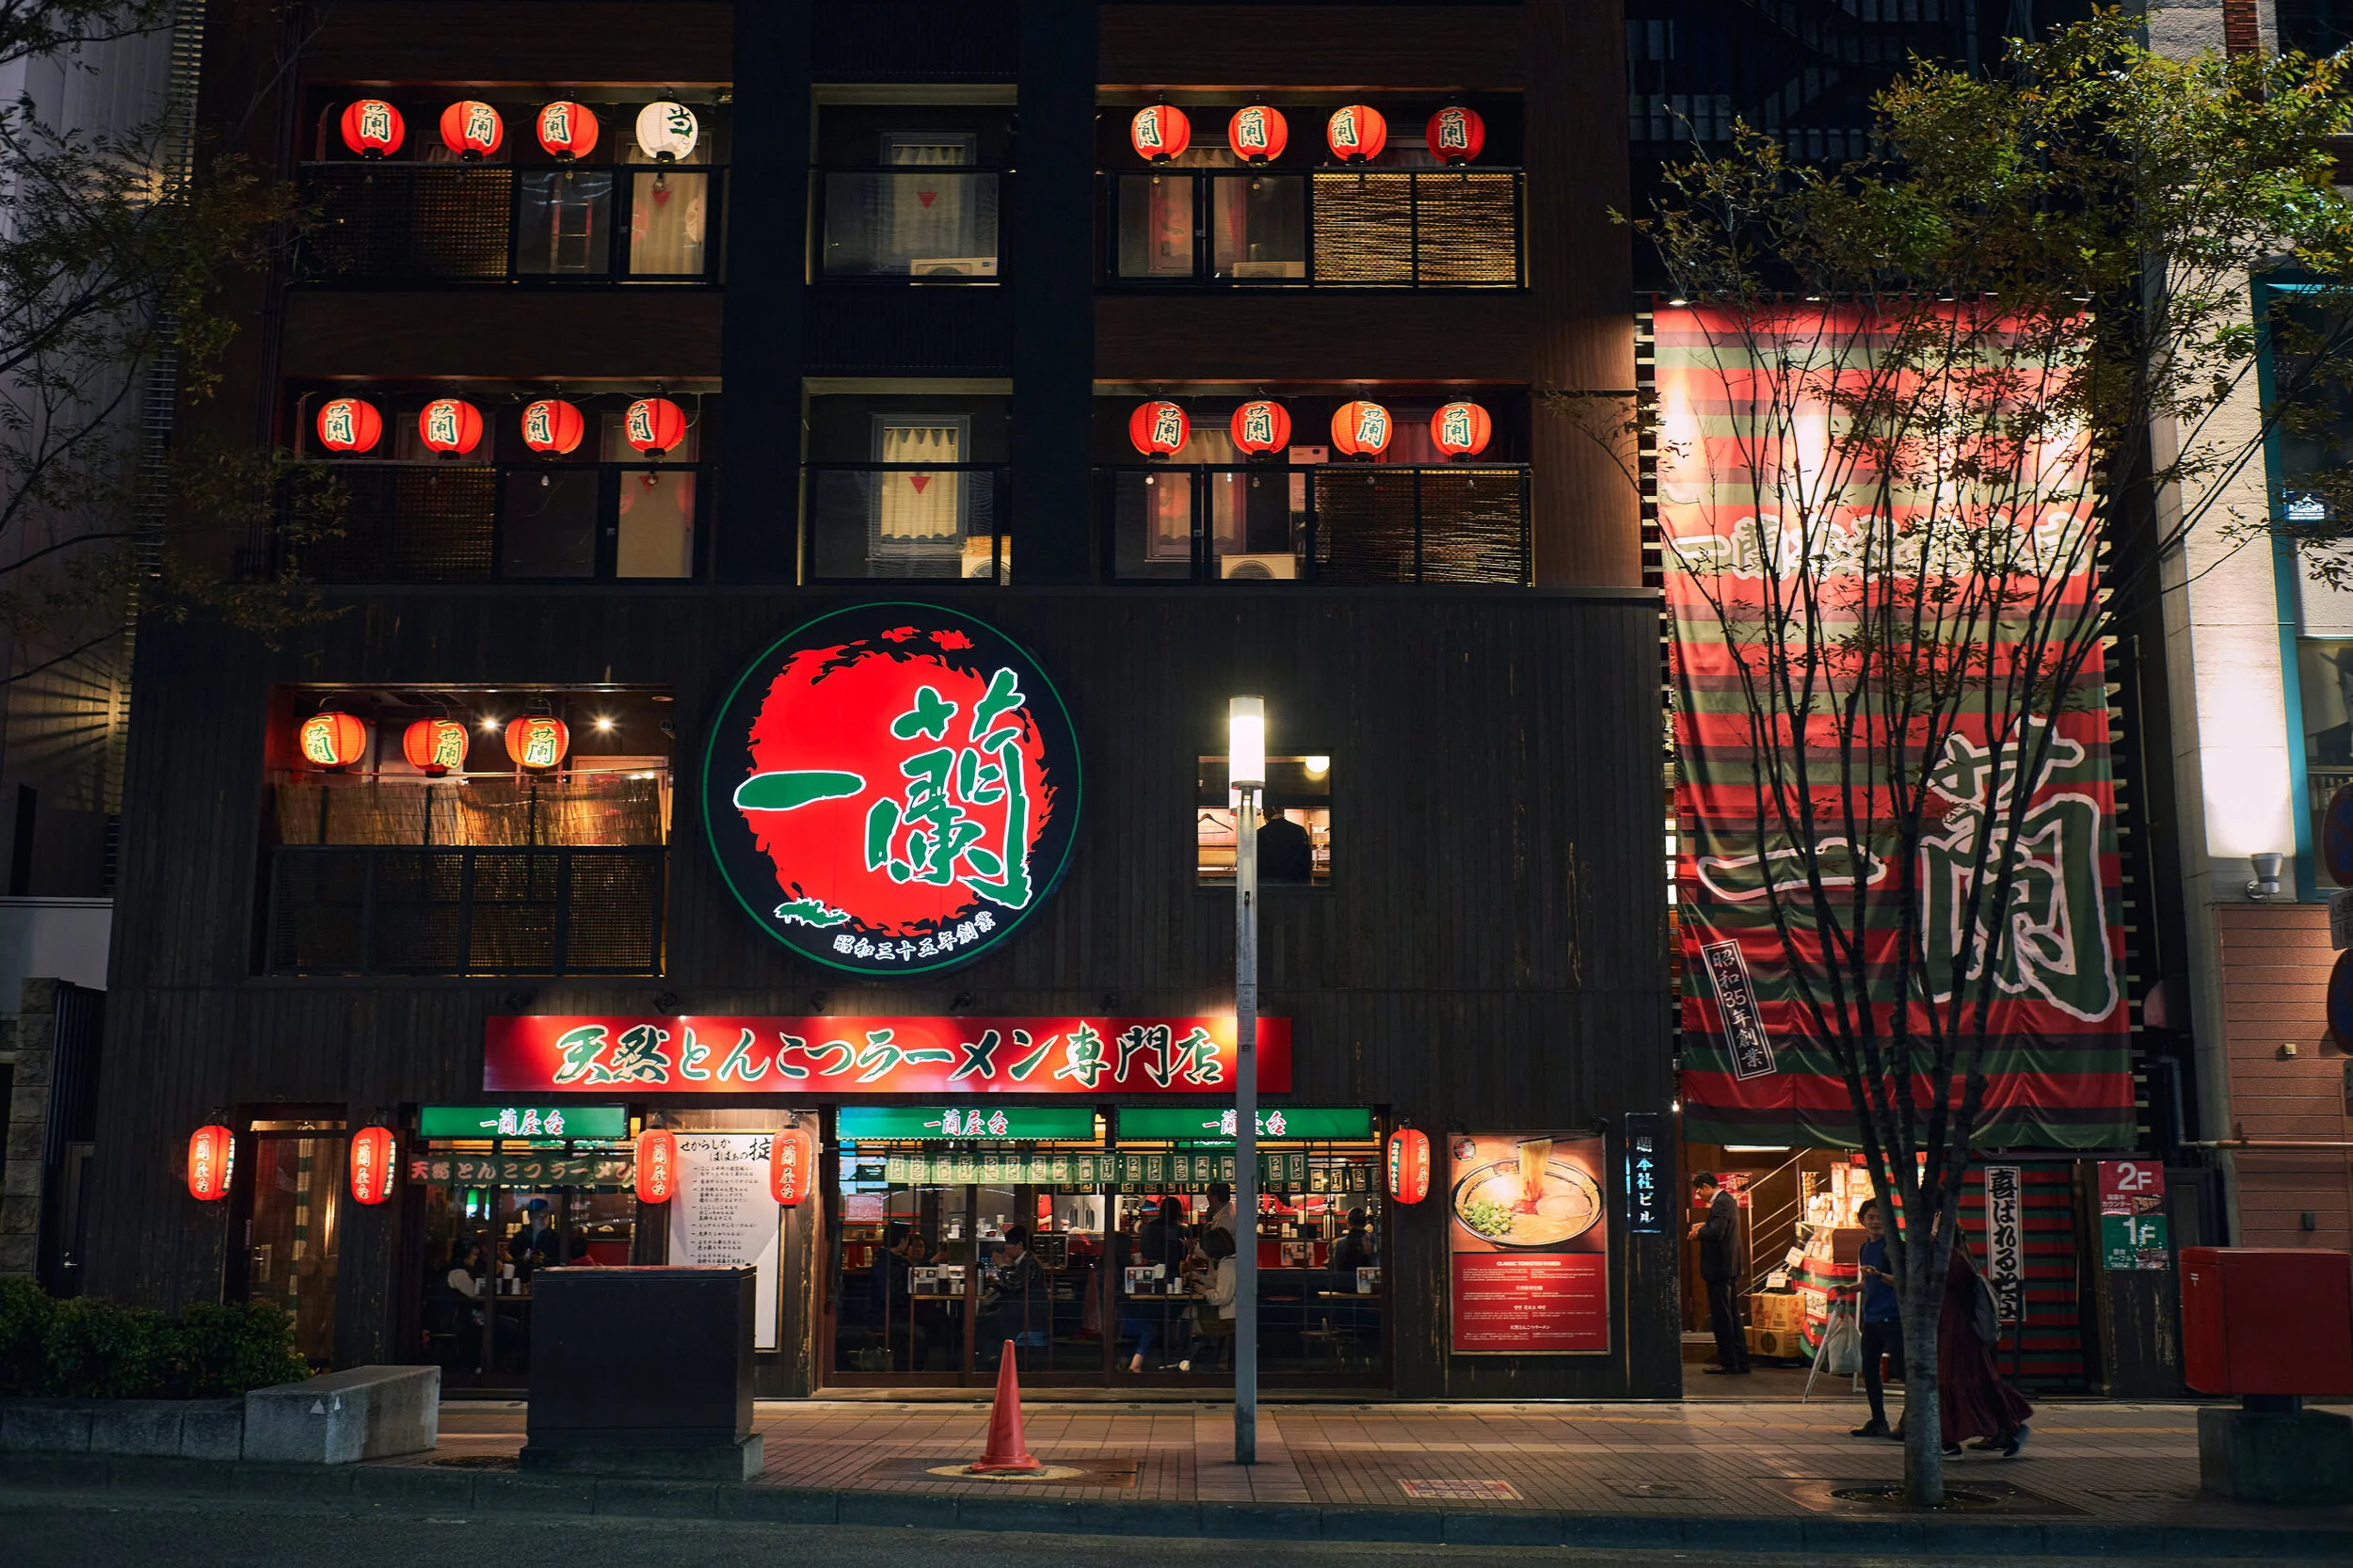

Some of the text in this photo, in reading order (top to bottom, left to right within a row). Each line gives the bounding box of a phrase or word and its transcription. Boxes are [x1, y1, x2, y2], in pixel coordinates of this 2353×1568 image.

[307, 715, 339, 764] 一蘭
[434, 719, 462, 768] 一蘭
[526, 718, 557, 766] 一蘭
[733, 667, 1033, 909] 一蘭
[1697, 717, 2118, 1022] 一蘭
[833, 911, 997, 961] 昭和三十五年創業
[1713, 949, 1764, 1067] 昭和35年創業
[552, 1021, 1225, 1088] 天然とんこつラーメン専門店
[480, 1108, 566, 1136] 一蘭屋台
[923, 1109, 1010, 1136] 一蘭屋台
[1637, 1124, 1656, 1224] 本社ビル
[2117, 1162, 2153, 1191] 2F
[2123, 1217, 2155, 1245] 1F
